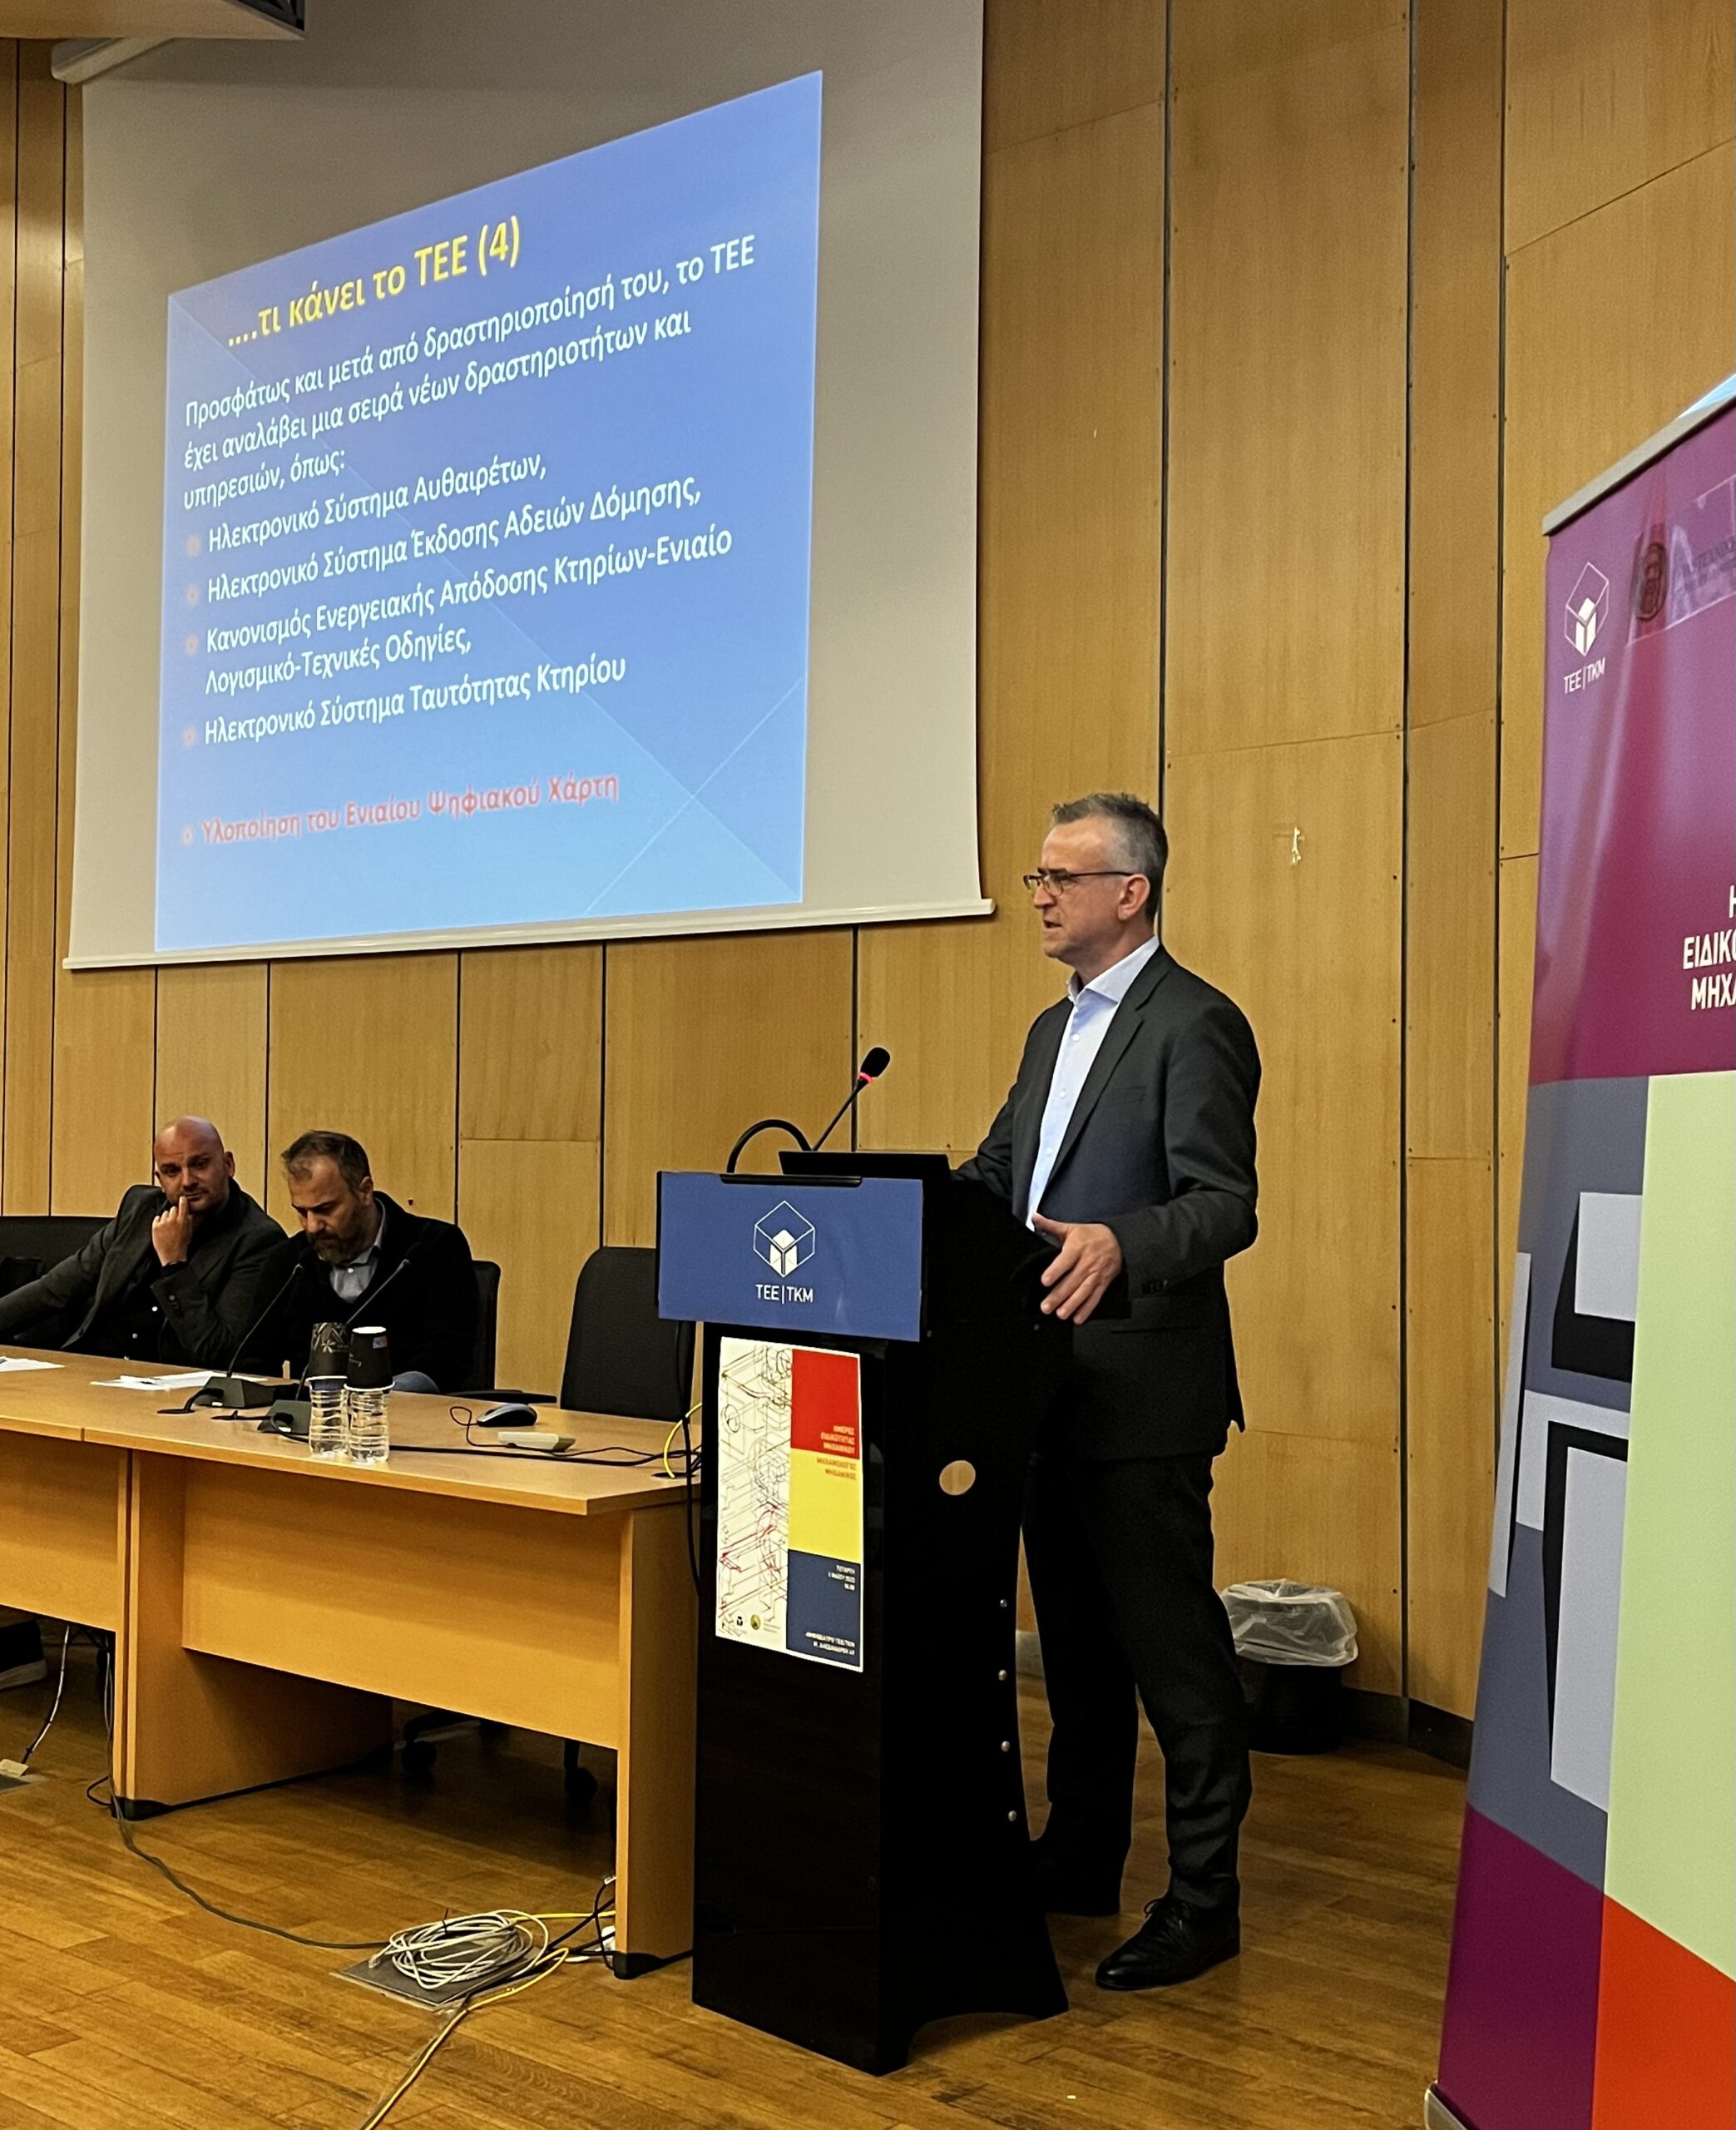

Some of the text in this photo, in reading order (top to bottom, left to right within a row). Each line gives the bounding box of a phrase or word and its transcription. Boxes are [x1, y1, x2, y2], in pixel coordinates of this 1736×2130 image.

[288, 280, 365, 327] κάνει
[373, 265, 406, 300] το
[414, 235, 467, 285] ΤΕΕ
[478, 215, 520, 275] (4)
[186, 235, 754, 428] Προσφάτως και μετά από δραστηριοποίησή του, το ΤΕΕ
[185, 311, 691, 471] έχει αναλάβει μια σειρά νέων δραστηριοτήτων και
[185, 450, 344, 509] υπηρεσιών, όπως:
[210, 454, 546, 552] Ηλεκτρονικό Σύστημα Αυθαιρέτων,
[209, 478, 700, 602] Ηλεκτρονικό Σύστημα Έκδοσης Αδειών Δόμησης,
[208, 608, 310, 652] Κανονισμός
[317, 582, 434, 631] Ενεργειακής
[440, 566, 547, 607] Απόδοσης
[385, 623, 472, 662] Οδηγίες,
[206, 653, 626, 744] Ηλεκτρονικό Σύστημα Ταυτότητας Κτηρίου
[200, 772, 618, 844] Υλοποίηση του Ενιαίου Ψηφιακού Χάρτη
